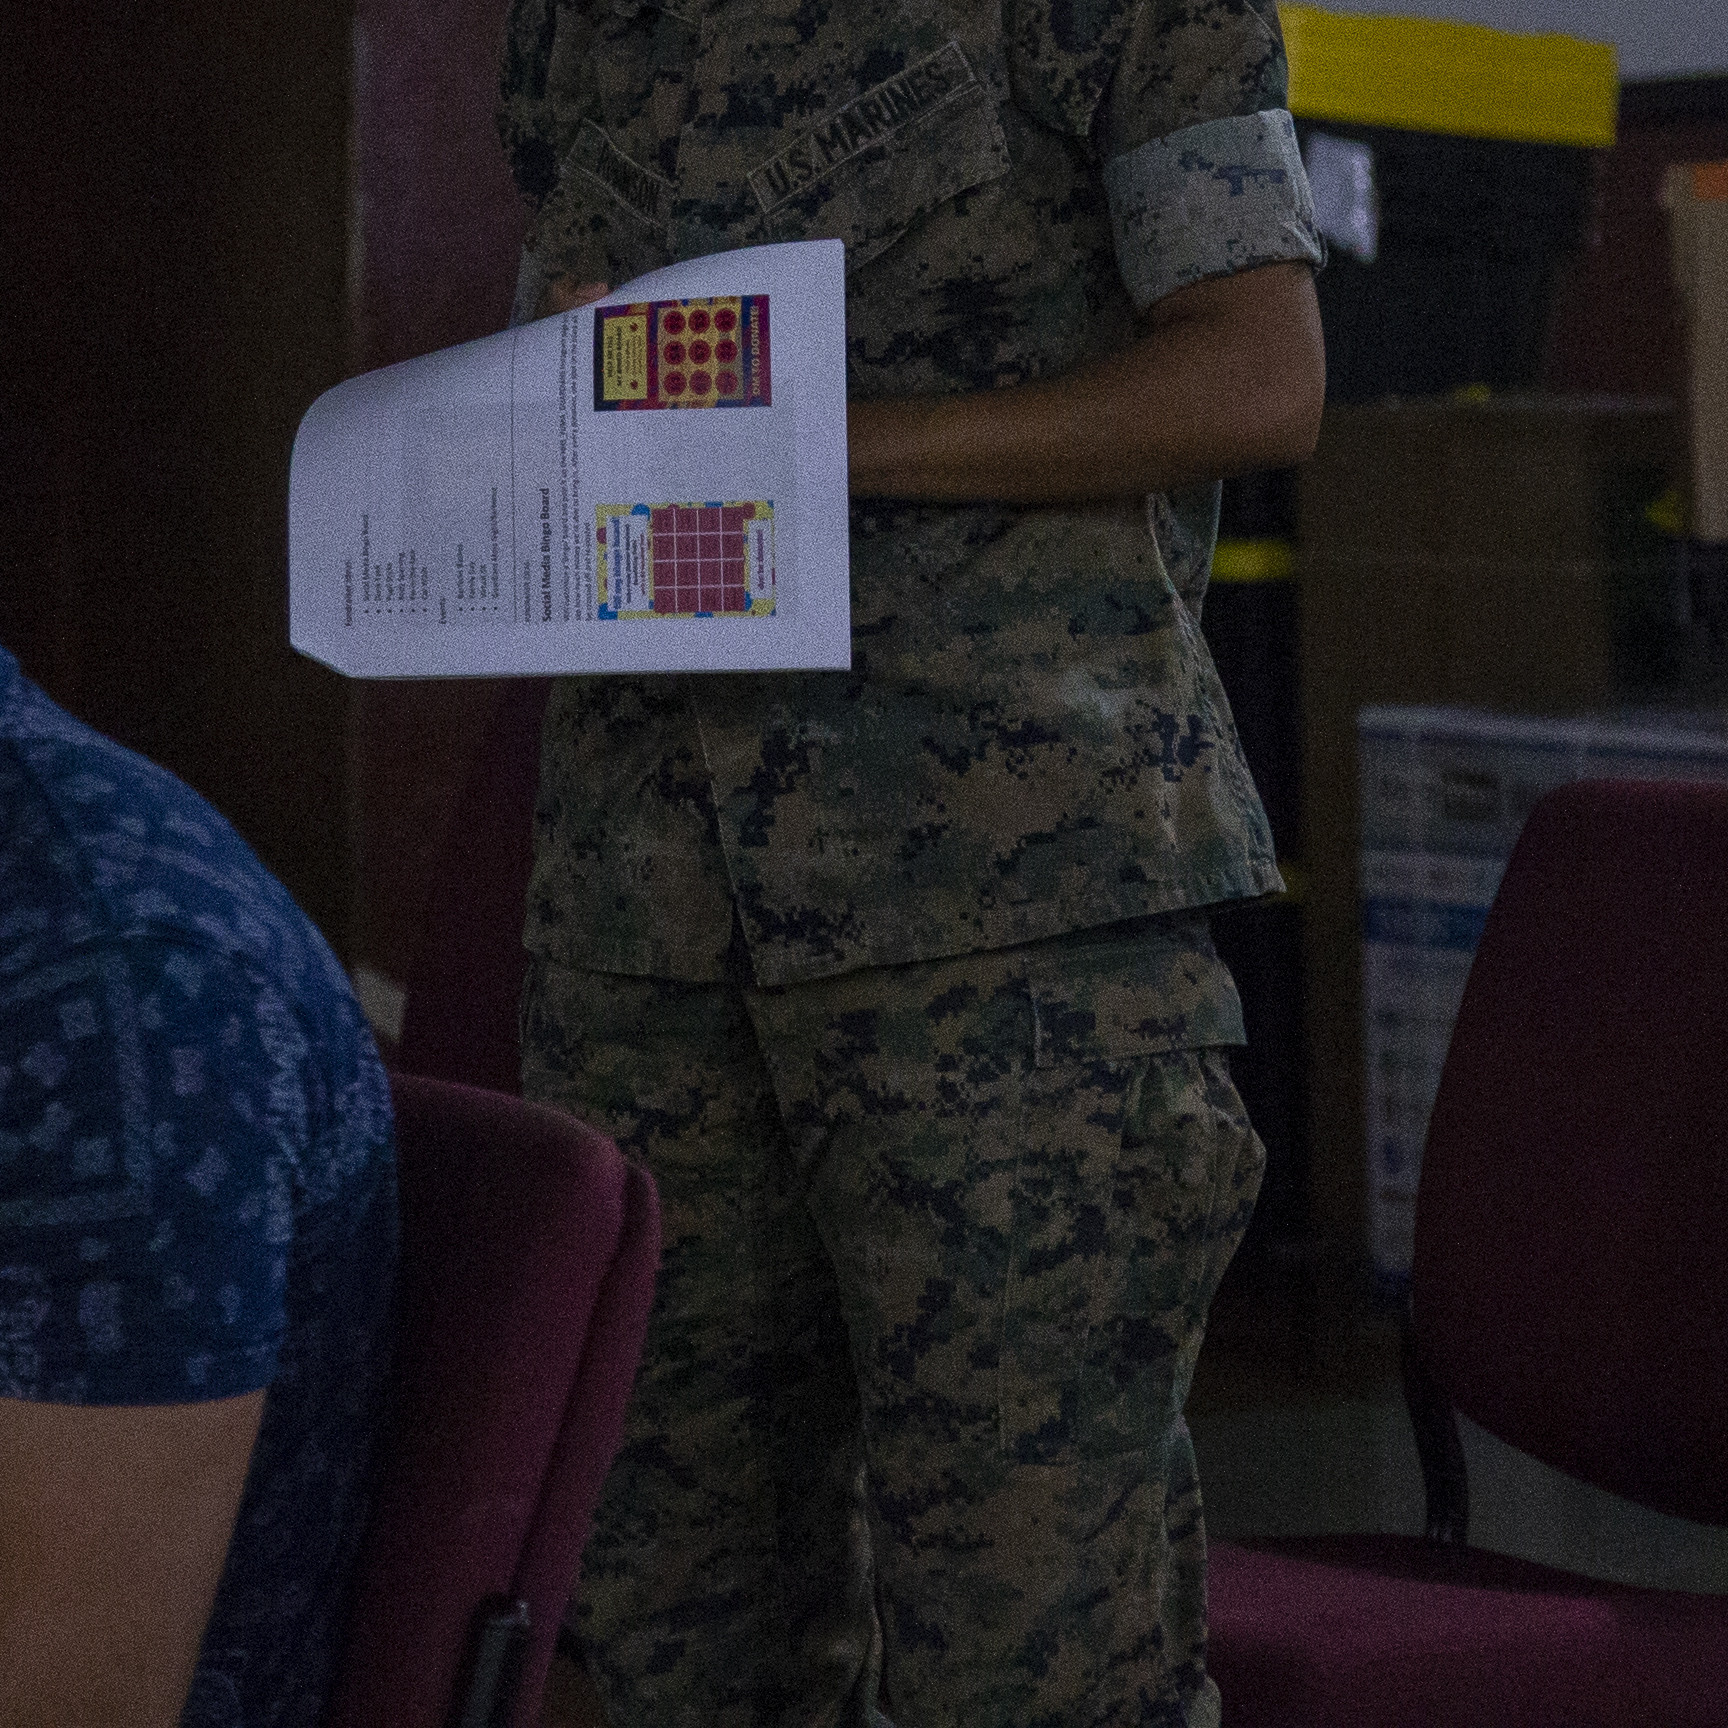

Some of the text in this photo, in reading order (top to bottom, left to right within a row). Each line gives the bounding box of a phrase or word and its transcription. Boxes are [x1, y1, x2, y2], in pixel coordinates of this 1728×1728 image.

[762, 61, 952, 193] U.S. MARINES
[752, 358, 760, 374] TO
[752, 376, 761, 396] DM
[539, 488, 552, 622] Social Media Bingo Board
